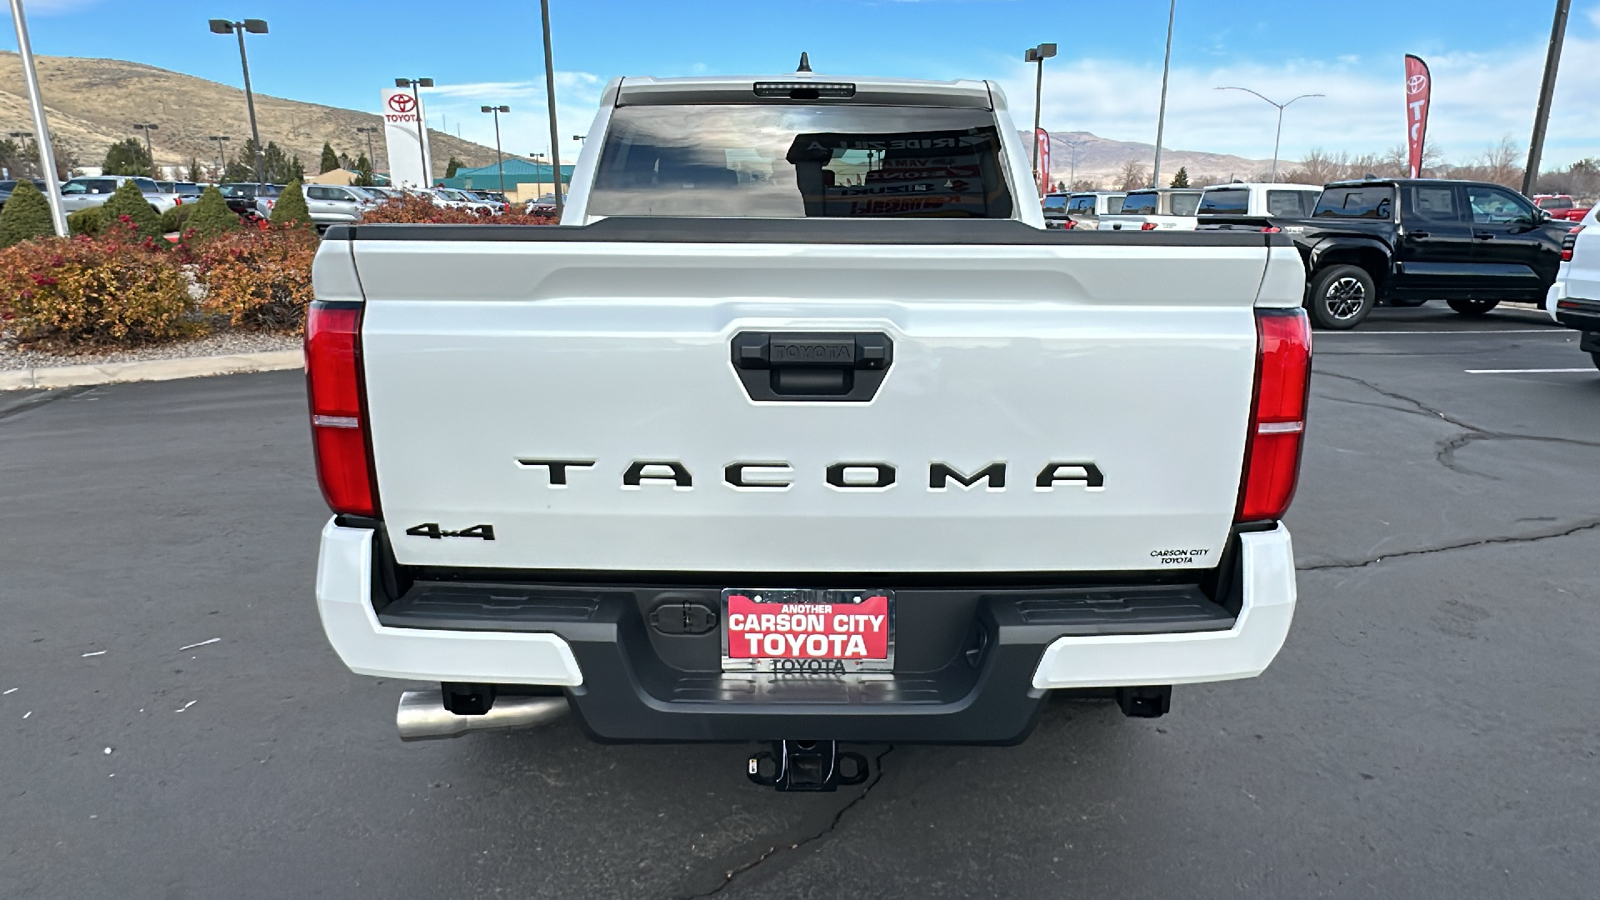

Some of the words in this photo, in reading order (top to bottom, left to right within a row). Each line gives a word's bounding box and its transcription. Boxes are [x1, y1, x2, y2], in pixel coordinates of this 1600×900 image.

[774, 345, 851, 359] TOYOTA
[515, 457, 1106, 492] TACOMA
[1150, 549, 1188, 557] CARSON
[1189, 548, 1210, 556] CITY
[1160, 556, 1193, 564] TOYOTA
[781, 604, 832, 614] ANOTHER
[729, 613, 824, 632] CARSON
[833, 614, 885, 632] CITY
[744, 632, 868, 656] TOYOTA
[772, 658, 846, 675] TOYOTA
